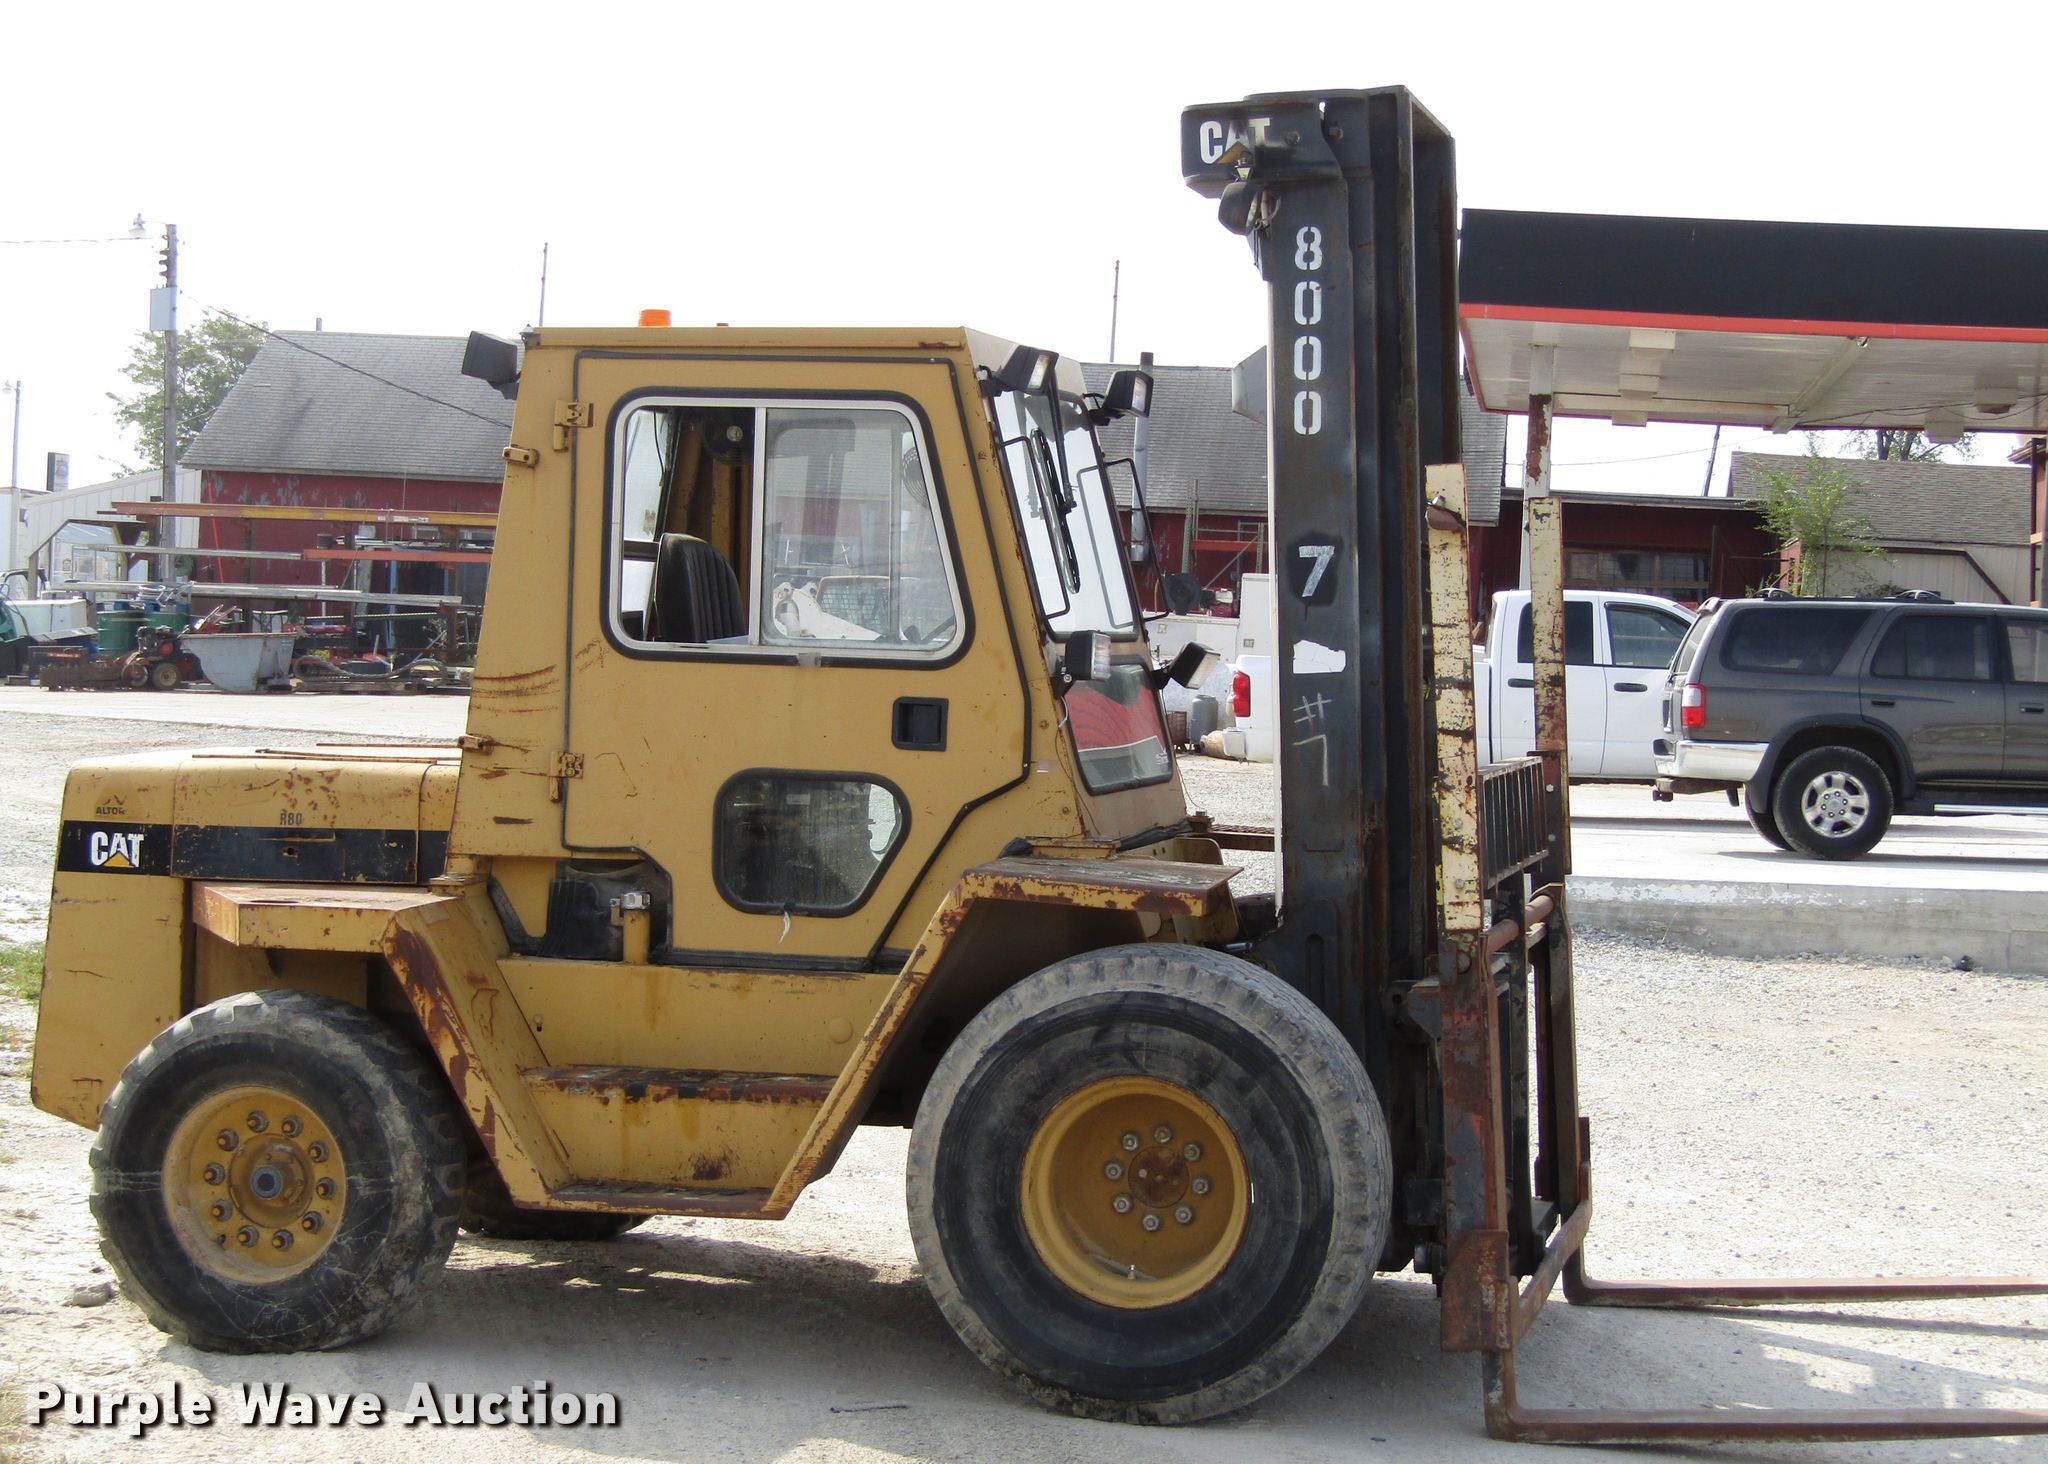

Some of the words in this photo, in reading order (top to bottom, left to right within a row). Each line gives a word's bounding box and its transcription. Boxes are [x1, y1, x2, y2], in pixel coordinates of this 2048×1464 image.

[1200, 117, 1271, 164] CAT
[1294, 226, 1323, 435] 8000
[1298, 545, 1335, 598] 7
[280, 812, 303, 826] R80
[91, 831, 144, 867] CAT
